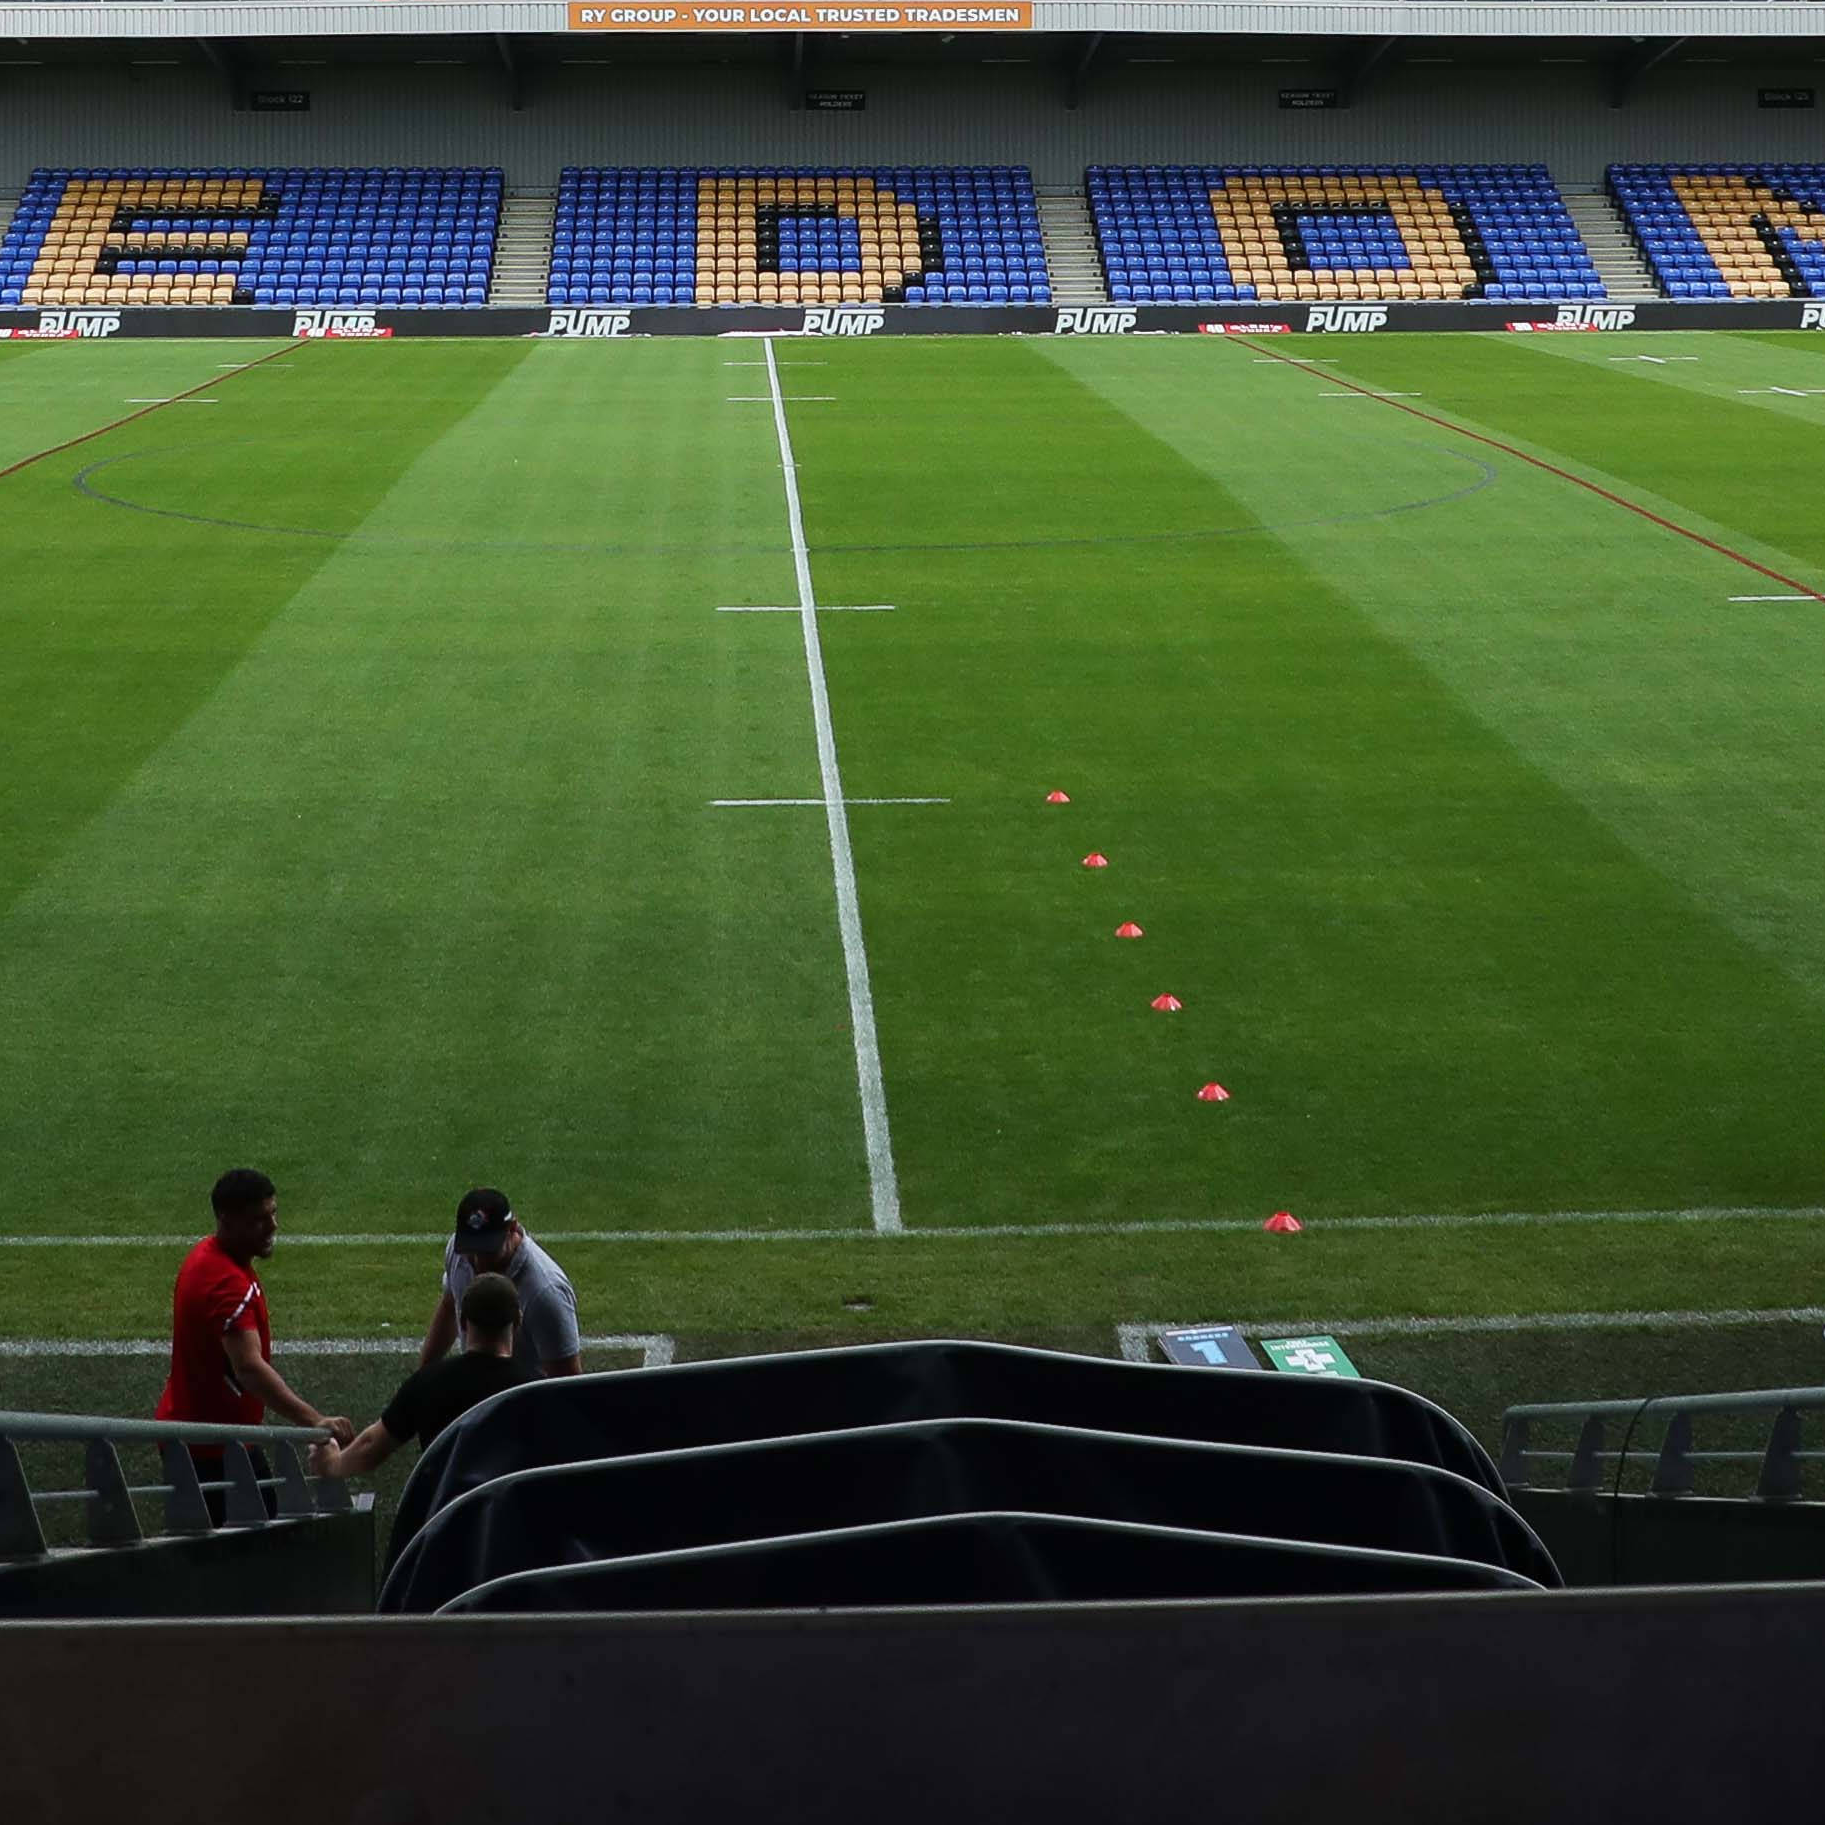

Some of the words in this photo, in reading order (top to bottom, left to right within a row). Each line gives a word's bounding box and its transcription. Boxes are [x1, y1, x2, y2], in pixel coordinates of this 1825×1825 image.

[581, 9, 606, 22] RY
[610, 9, 677, 23] GROUP
[693, 9, 745, 22] YOUR
[750, 9, 812, 22] LOCAL
[815, 8, 900, 22] TRUSTED
[904, 8, 1019, 22] TRADESMEN
[39, 311, 121, 337] PUMP
[293, 310, 376, 336] PUMP
[549, 310, 631, 336] PUMP
[803, 309, 885, 334] PUMP
[1055, 308, 1137, 333] PUMP
[1306, 306, 1388, 331] PUMP
[1555, 305, 1635, 329] PUMP
